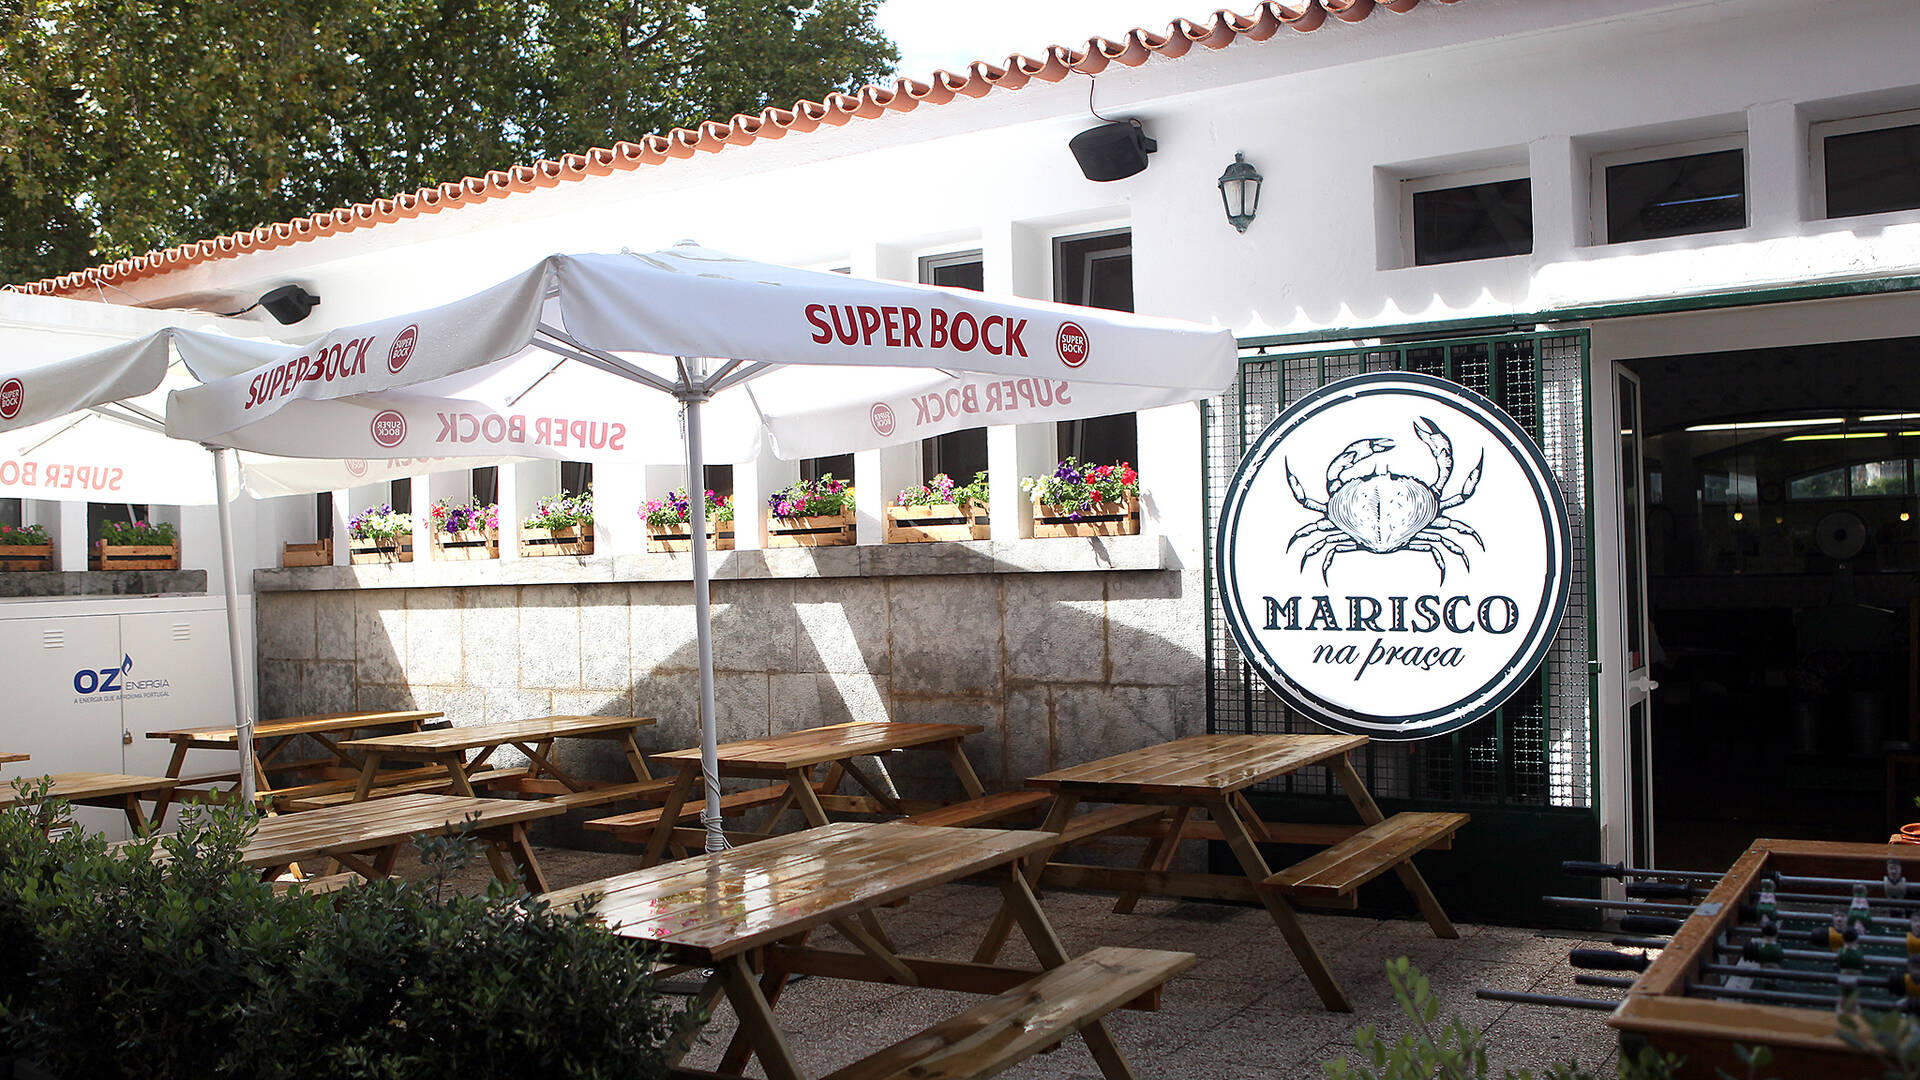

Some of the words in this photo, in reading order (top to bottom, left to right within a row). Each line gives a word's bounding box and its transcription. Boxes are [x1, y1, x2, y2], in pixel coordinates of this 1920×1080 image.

[805, 303, 923, 348] SUPER
[930, 308, 1029, 357] BOCK
[1061, 334, 1084, 345] SUPER
[1062, 343, 1083, 354] BOCK
[245, 356, 310, 409] SUPER
[303, 336, 376, 382] BOCK
[1262, 595, 1520, 634] MARISCO
[1312, 644, 1360, 665] na
[1354, 638, 1466, 682] praça
[74, 668, 121, 694] OZ
[125, 680, 170, 690] ENERGIA
